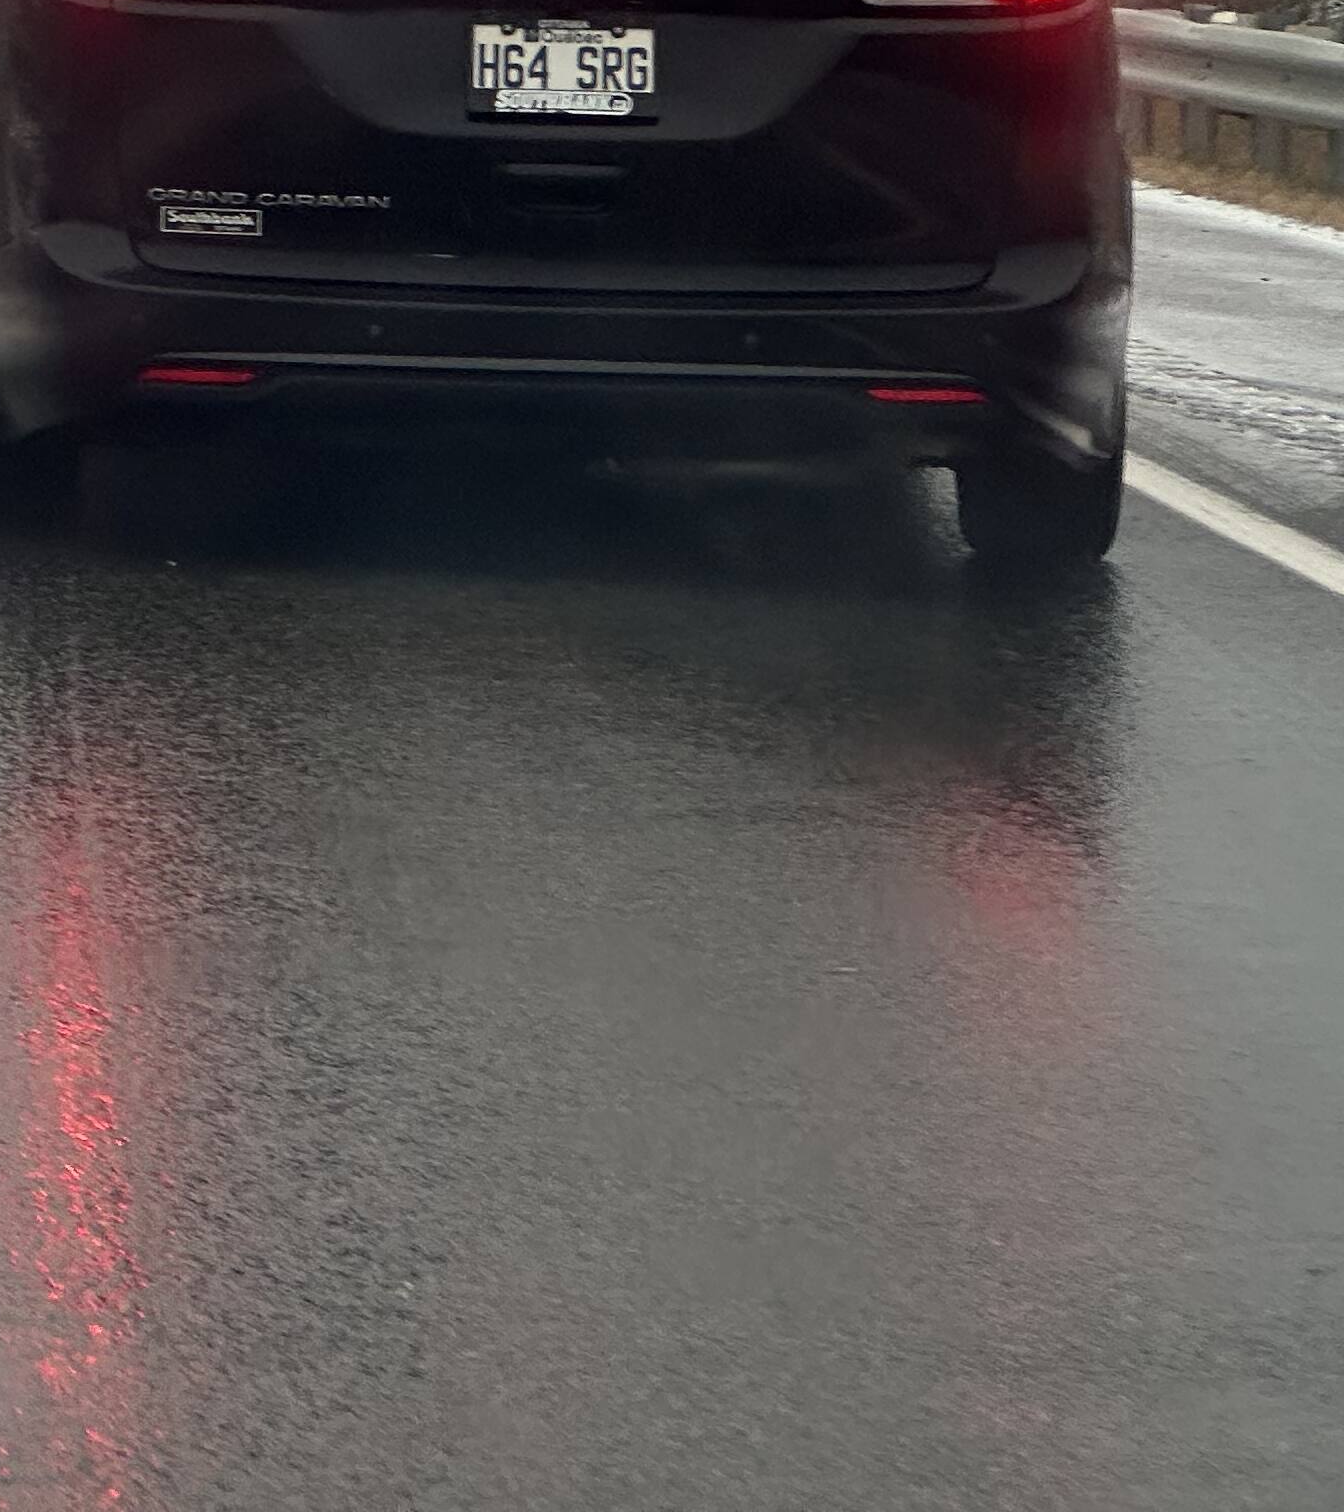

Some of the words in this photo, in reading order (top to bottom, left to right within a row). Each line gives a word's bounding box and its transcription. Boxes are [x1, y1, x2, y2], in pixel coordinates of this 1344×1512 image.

[479, 44, 548, 89] H64
[577, 46, 648, 91] SRG
[148, 188, 248, 205] GRAND
[256, 193, 391, 209] CARAVAN
